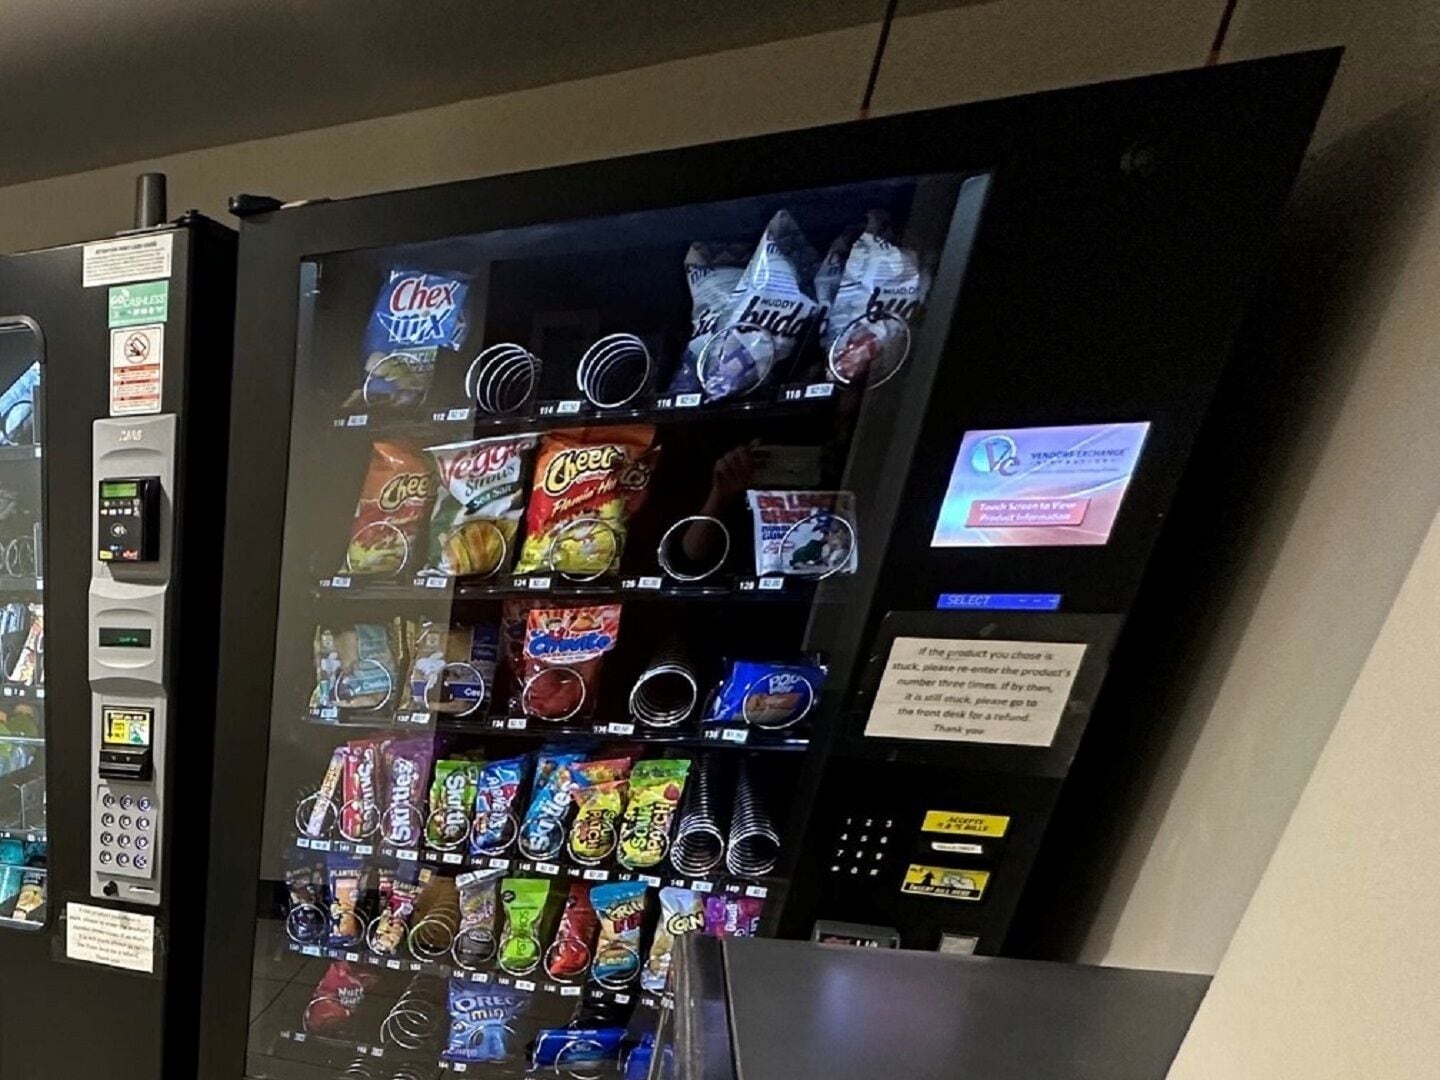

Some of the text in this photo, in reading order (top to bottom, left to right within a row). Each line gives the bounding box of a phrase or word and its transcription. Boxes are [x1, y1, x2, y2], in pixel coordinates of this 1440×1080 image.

[391, 274, 458, 311] Chex
[761, 299, 796, 310] MUDDY
[464, 460, 515, 498] Straws
[472, 491, 491, 508] Sea
[980, 502, 1077, 511] Touch Screen to View
[980, 513, 1071, 522] Product Information
[947, 596, 991, 606] SELECT
[928, 648, 945, 657] the
[946, 648, 988, 660] product
[989, 650, 1009, 660] you
[1043, 651, 1053, 660] is
[922, 663, 955, 674] please
[956, 666, 999, 675] re-enter
[1000, 666, 1019, 675] the
[1020, 667, 1071, 679] product's
[896, 678, 936, 687] number
[938, 678, 965, 688] three
[1011, 682, 1024, 692] by
[904, 692, 913, 701] it
[913, 693, 922, 701] is
[923, 693, 940, 702] still
[974, 696, 1007, 706] please
[1009, 699, 1024, 708] go
[1026, 699, 1038, 708] to
[898, 707, 914, 716] the
[915, 708, 941, 718] front
[942, 709, 965, 719] desk
[967, 710, 982, 721] for
[933, 723, 985, 736] Thank you
[390, 757, 413, 841] Skittles
[587, 809, 601, 850] PATCH
[629, 805, 655, 850] SOUR
[647, 802, 670, 851] PATCH
[667, 911, 705, 936] CORN
[453, 996, 515, 1013] OREO
